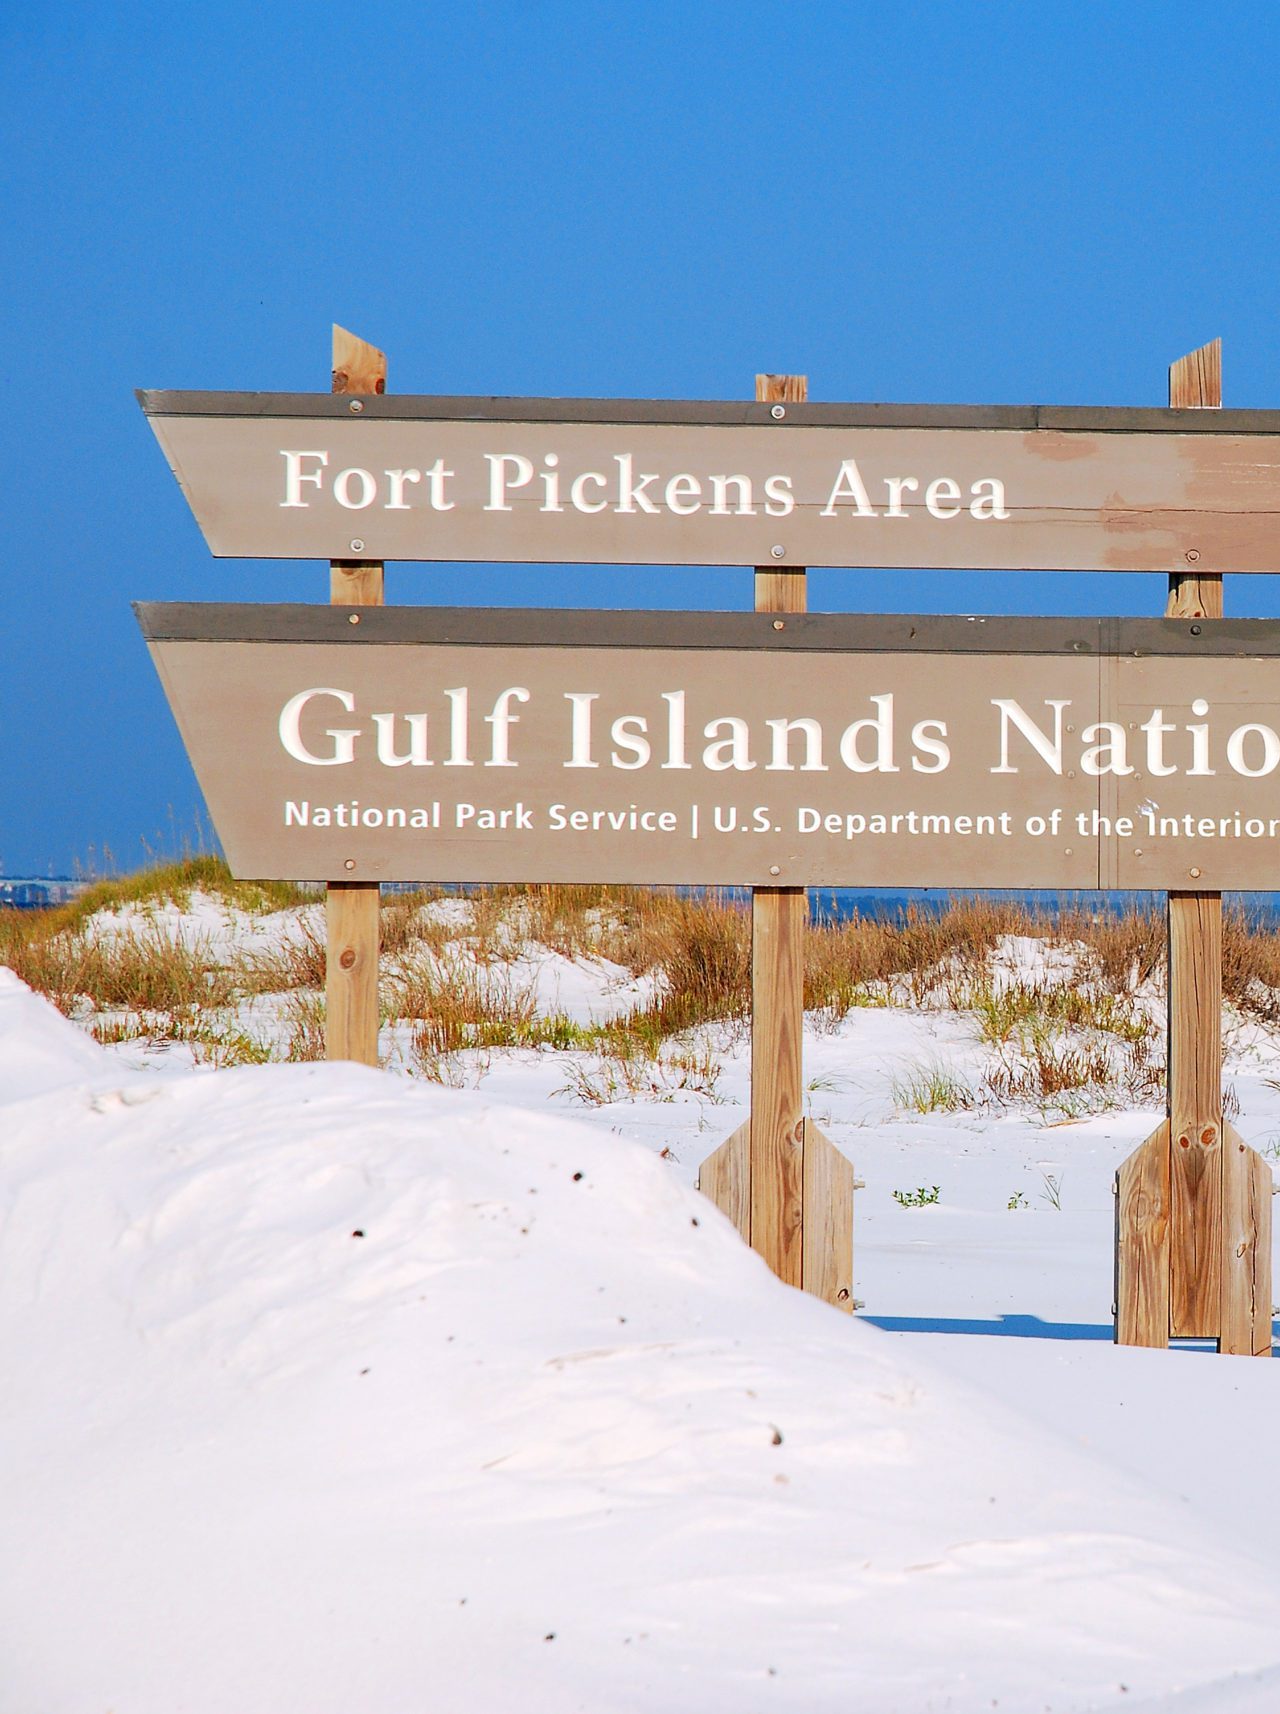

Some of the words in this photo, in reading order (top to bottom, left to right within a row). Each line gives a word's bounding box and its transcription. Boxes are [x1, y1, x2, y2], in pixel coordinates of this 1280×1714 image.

[279, 450, 455, 511] Fort
[483, 453, 795, 517] Pickens
[819, 459, 1011, 520] Area
[278, 687, 530, 767] Gulf
[563, 690, 951, 774] Islands
[285, 800, 440, 828] National
[456, 803, 533, 829] Park
[548, 804, 677, 832] Service
[714, 806, 781, 833] U.S.
[798, 807, 1012, 840] Department
[1025, 808, 1062, 836] of
[1075, 809, 1134, 836] the
[1146, 808, 1280, 839] Interior
